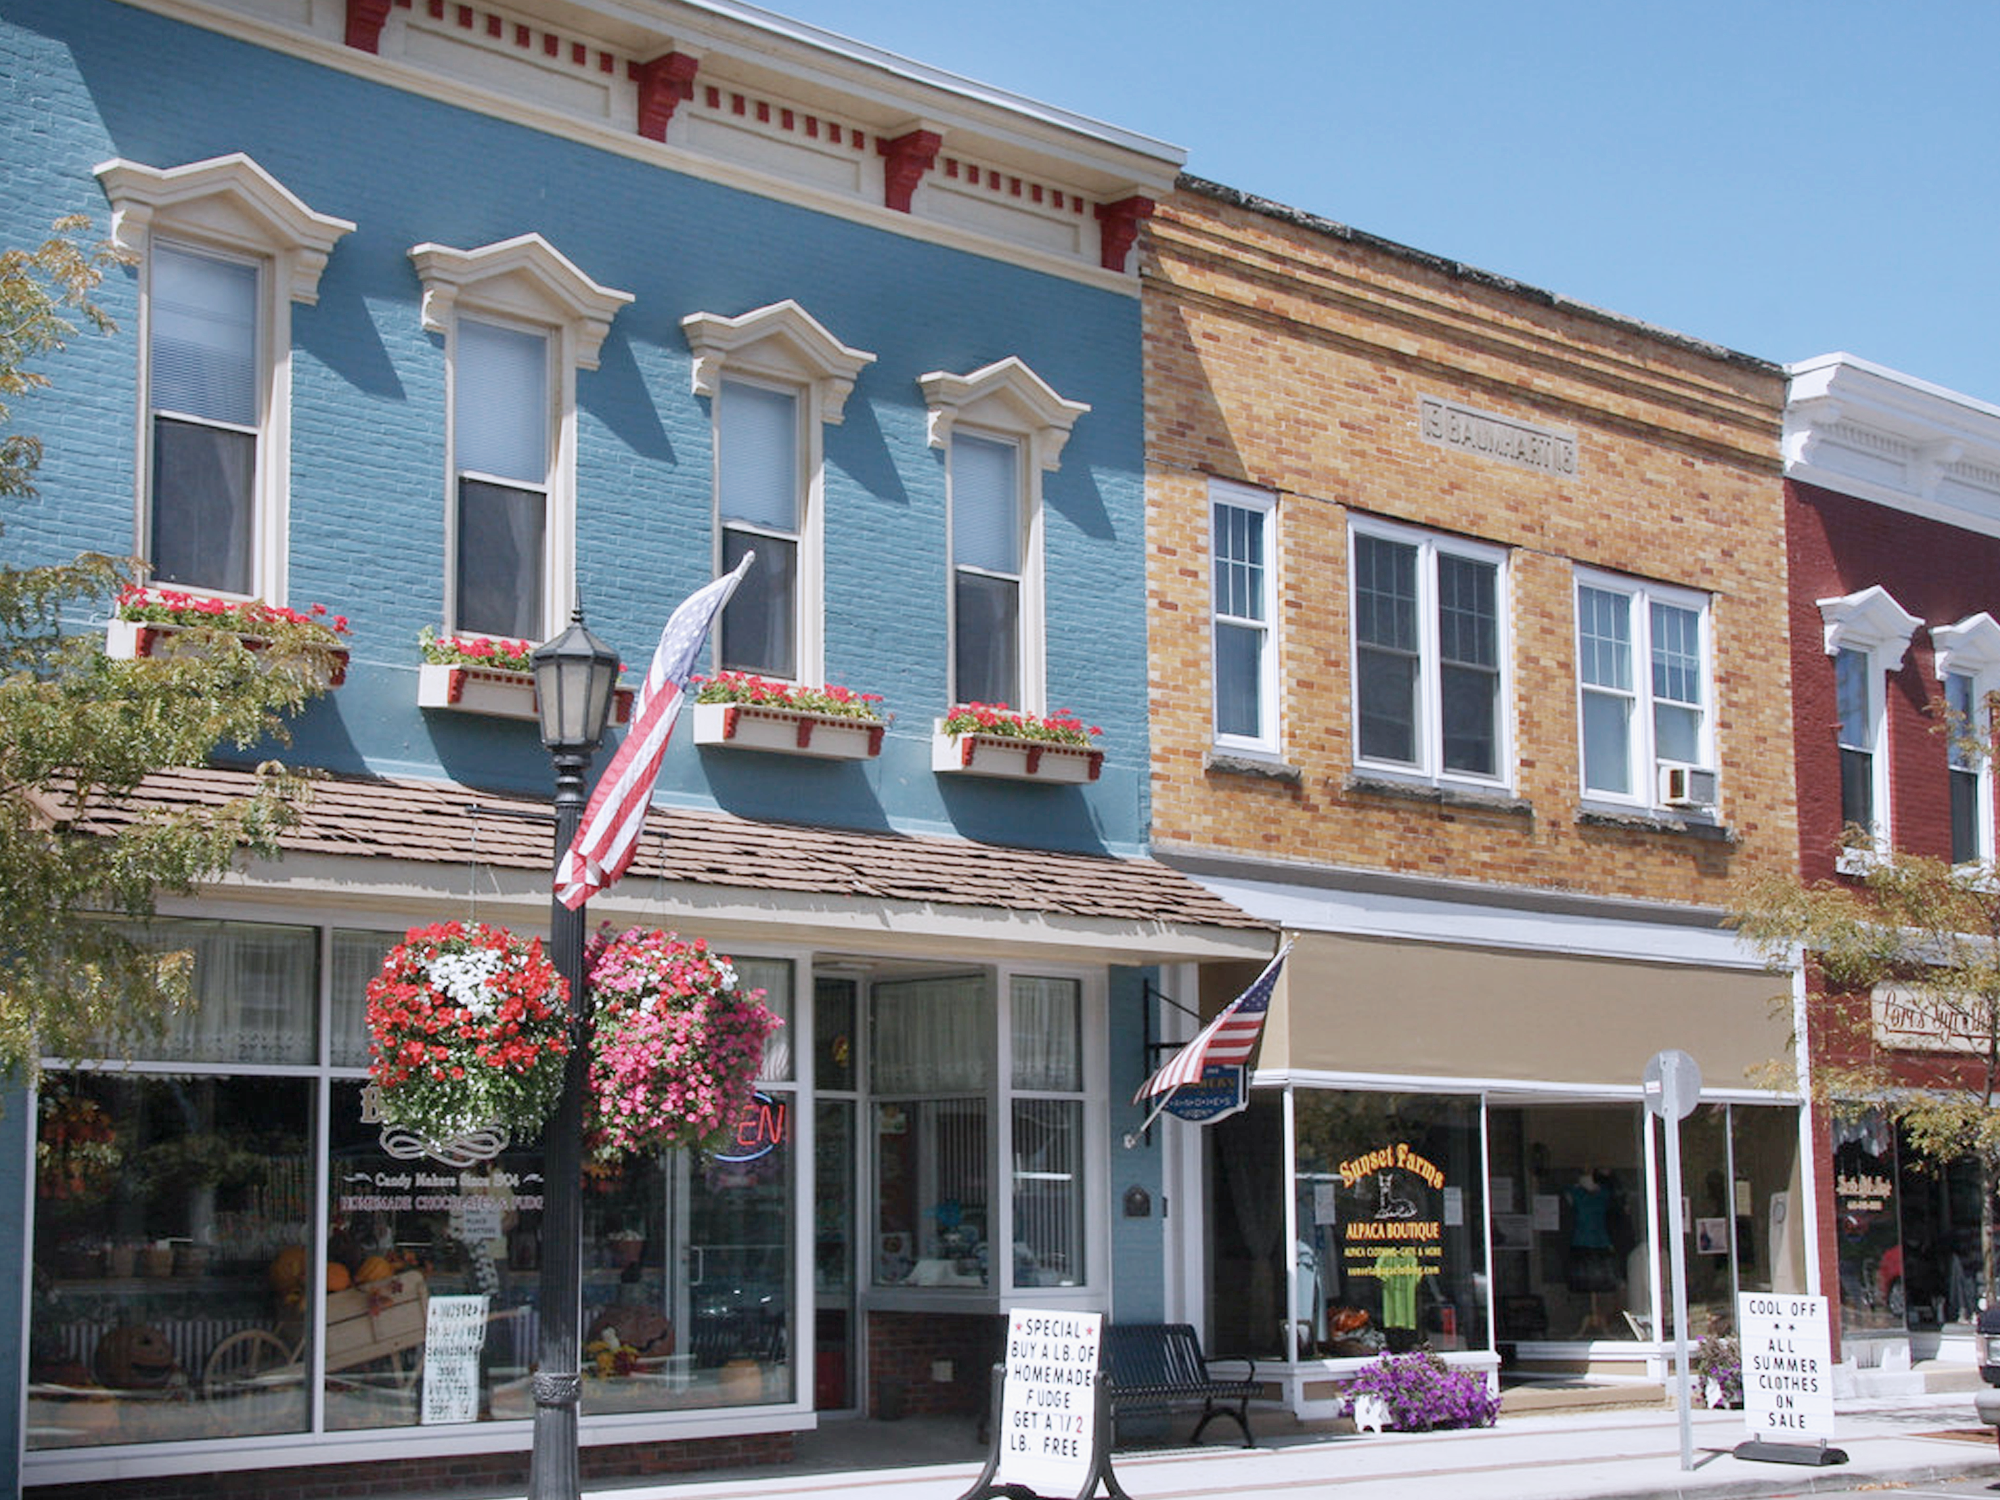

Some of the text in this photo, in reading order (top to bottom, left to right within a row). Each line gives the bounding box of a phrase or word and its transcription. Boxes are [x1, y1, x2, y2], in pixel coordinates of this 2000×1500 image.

[1339, 1143, 1445, 1189] Sunset Farms
[375, 1173, 411, 1190] Candy
[1345, 1222, 1440, 1241] ALPACA BOUTIQUE
[1749, 1300, 1817, 1317] COOL OFF
[1026, 1318, 1081, 1339] SPECIAL
[1011, 1341, 1095, 1363] BUY A LB. OF
[1768, 1339, 1795, 1353] ALL
[1753, 1356, 1818, 1374] SUMMER
[1013, 1364, 1092, 1386] HOMEMADE
[1759, 1374, 1818, 1392] CLOTHES
[1026, 1389, 1071, 1409] FUDGE
[1776, 1394, 1794, 1408] ON
[1013, 1411, 1083, 1434] GET A 1/2
[1769, 1413, 1806, 1429] SALE
[1011, 1434, 1079, 1457] LB. FREE
